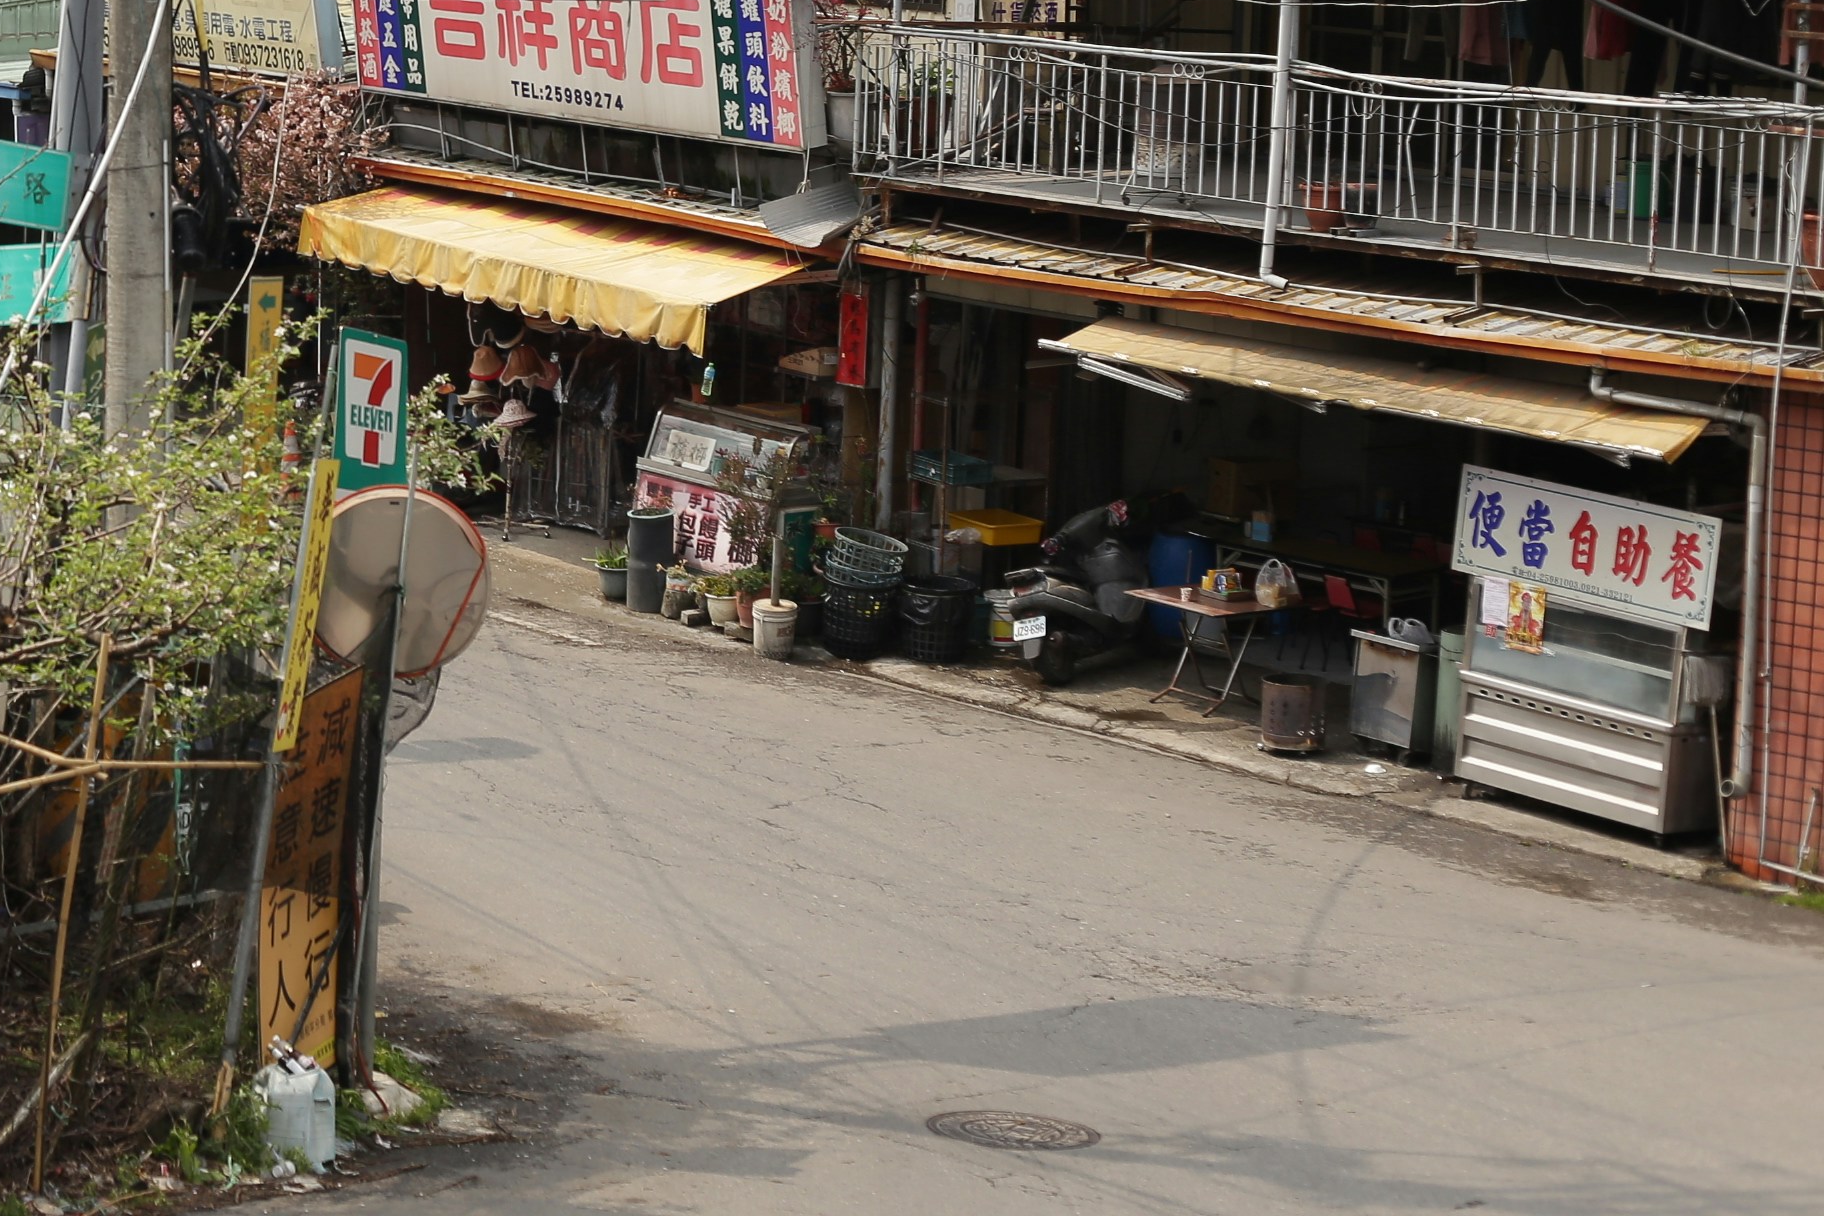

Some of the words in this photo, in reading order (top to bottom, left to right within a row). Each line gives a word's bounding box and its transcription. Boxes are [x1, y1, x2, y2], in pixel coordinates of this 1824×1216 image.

[510, 80, 624, 111] TEL:25989274
[353, 351, 393, 465] 7
[1469, 490, 1704, 602] 便當自助餐
[304, 697, 351, 993] 減速慢行
